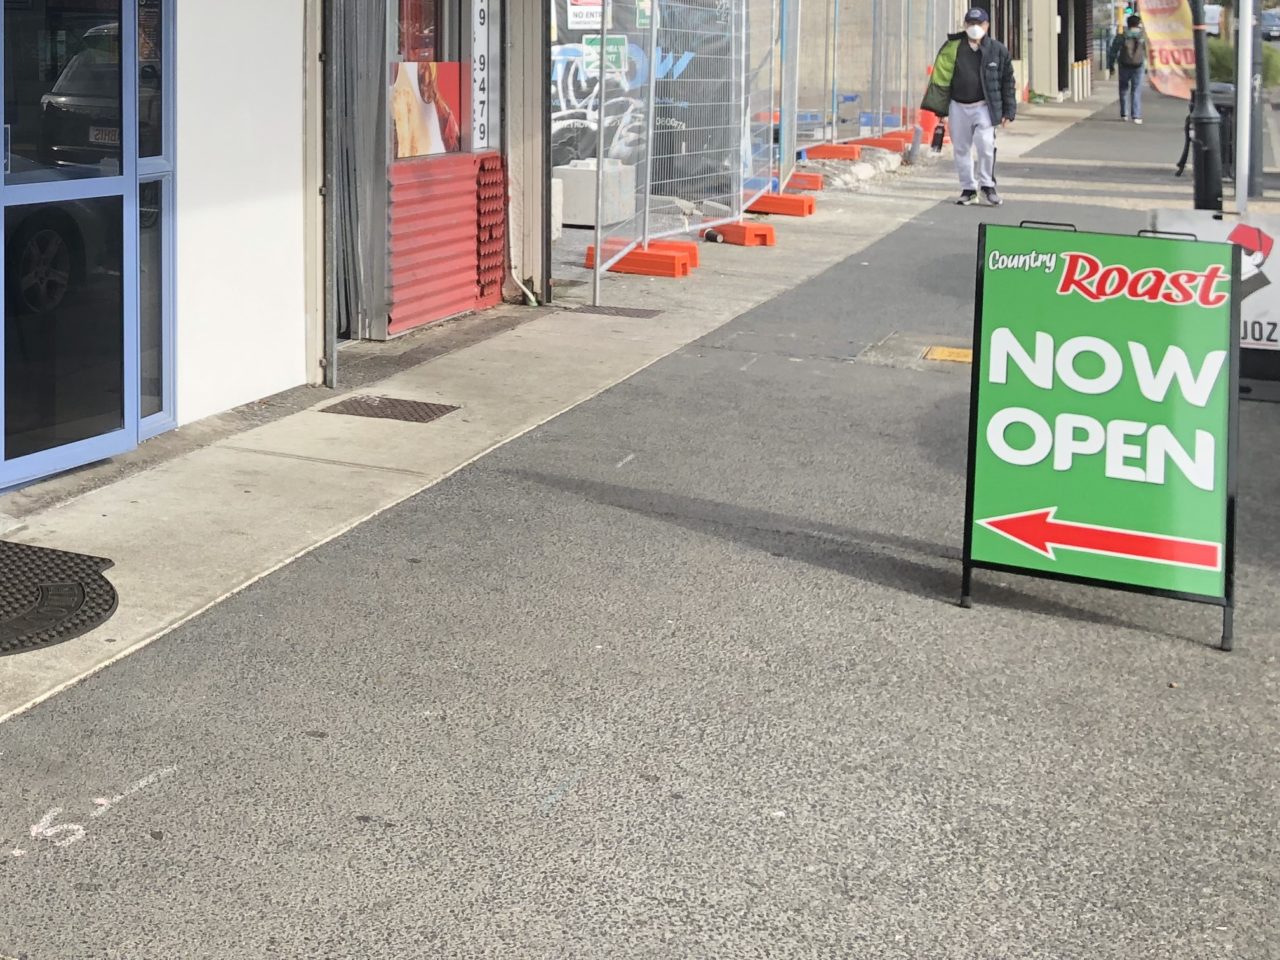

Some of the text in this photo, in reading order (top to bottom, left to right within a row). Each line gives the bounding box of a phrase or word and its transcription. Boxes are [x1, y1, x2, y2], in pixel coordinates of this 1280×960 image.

[988, 250, 1232, 309] Country Roast
[988, 326, 1228, 408] NOW
[986, 406, 1216, 492] OPEN
